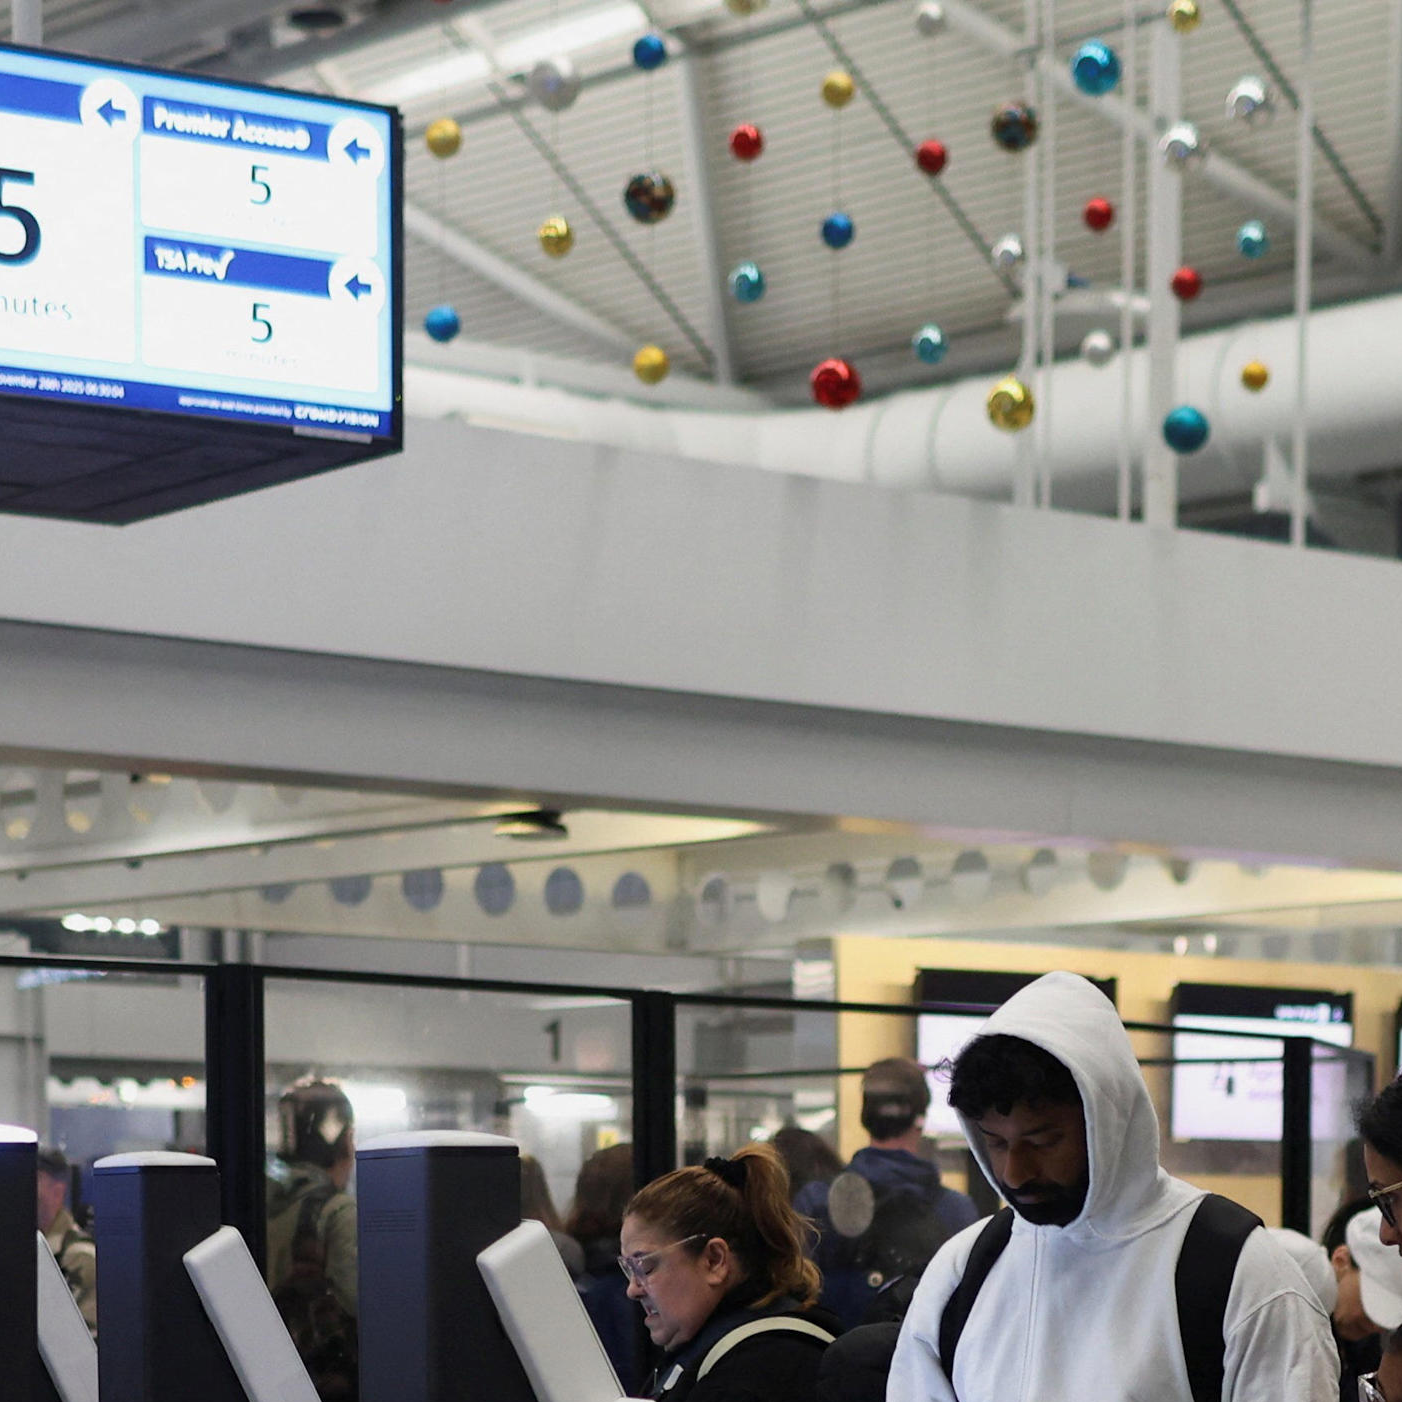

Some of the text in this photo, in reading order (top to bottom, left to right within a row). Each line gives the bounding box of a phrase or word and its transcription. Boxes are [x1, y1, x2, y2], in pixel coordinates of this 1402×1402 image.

[154, 105, 231, 140] Premier
[250, 164, 272, 205] 5
[154, 249, 186, 274] TSA
[251, 302, 273, 343] 5
[542, 1019, 561, 1061] 1
